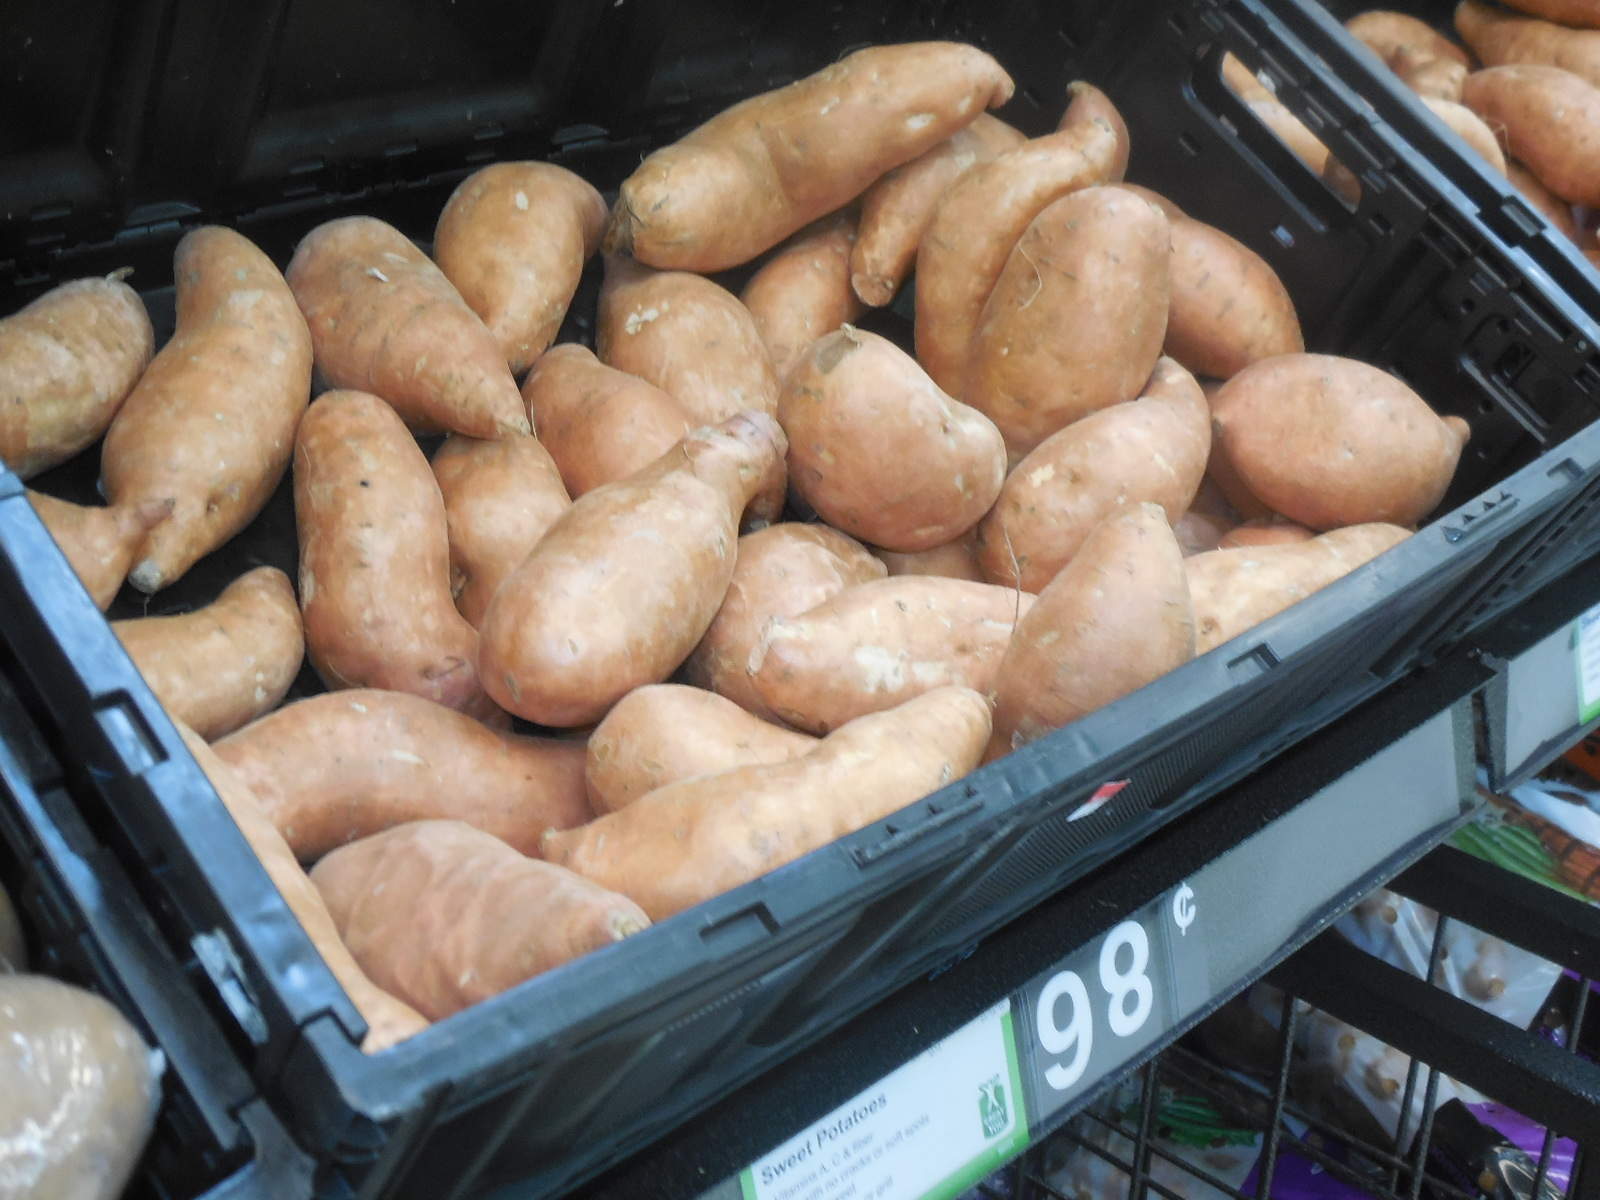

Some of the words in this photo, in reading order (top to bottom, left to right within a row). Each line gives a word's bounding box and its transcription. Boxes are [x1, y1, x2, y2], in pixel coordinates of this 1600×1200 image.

[1037, 920, 1153, 1090] 98
[1173, 882, 1196, 936] ¢
[761, 1140, 812, 1186] Sweet
[816, 1093, 887, 1148] Potatoes
